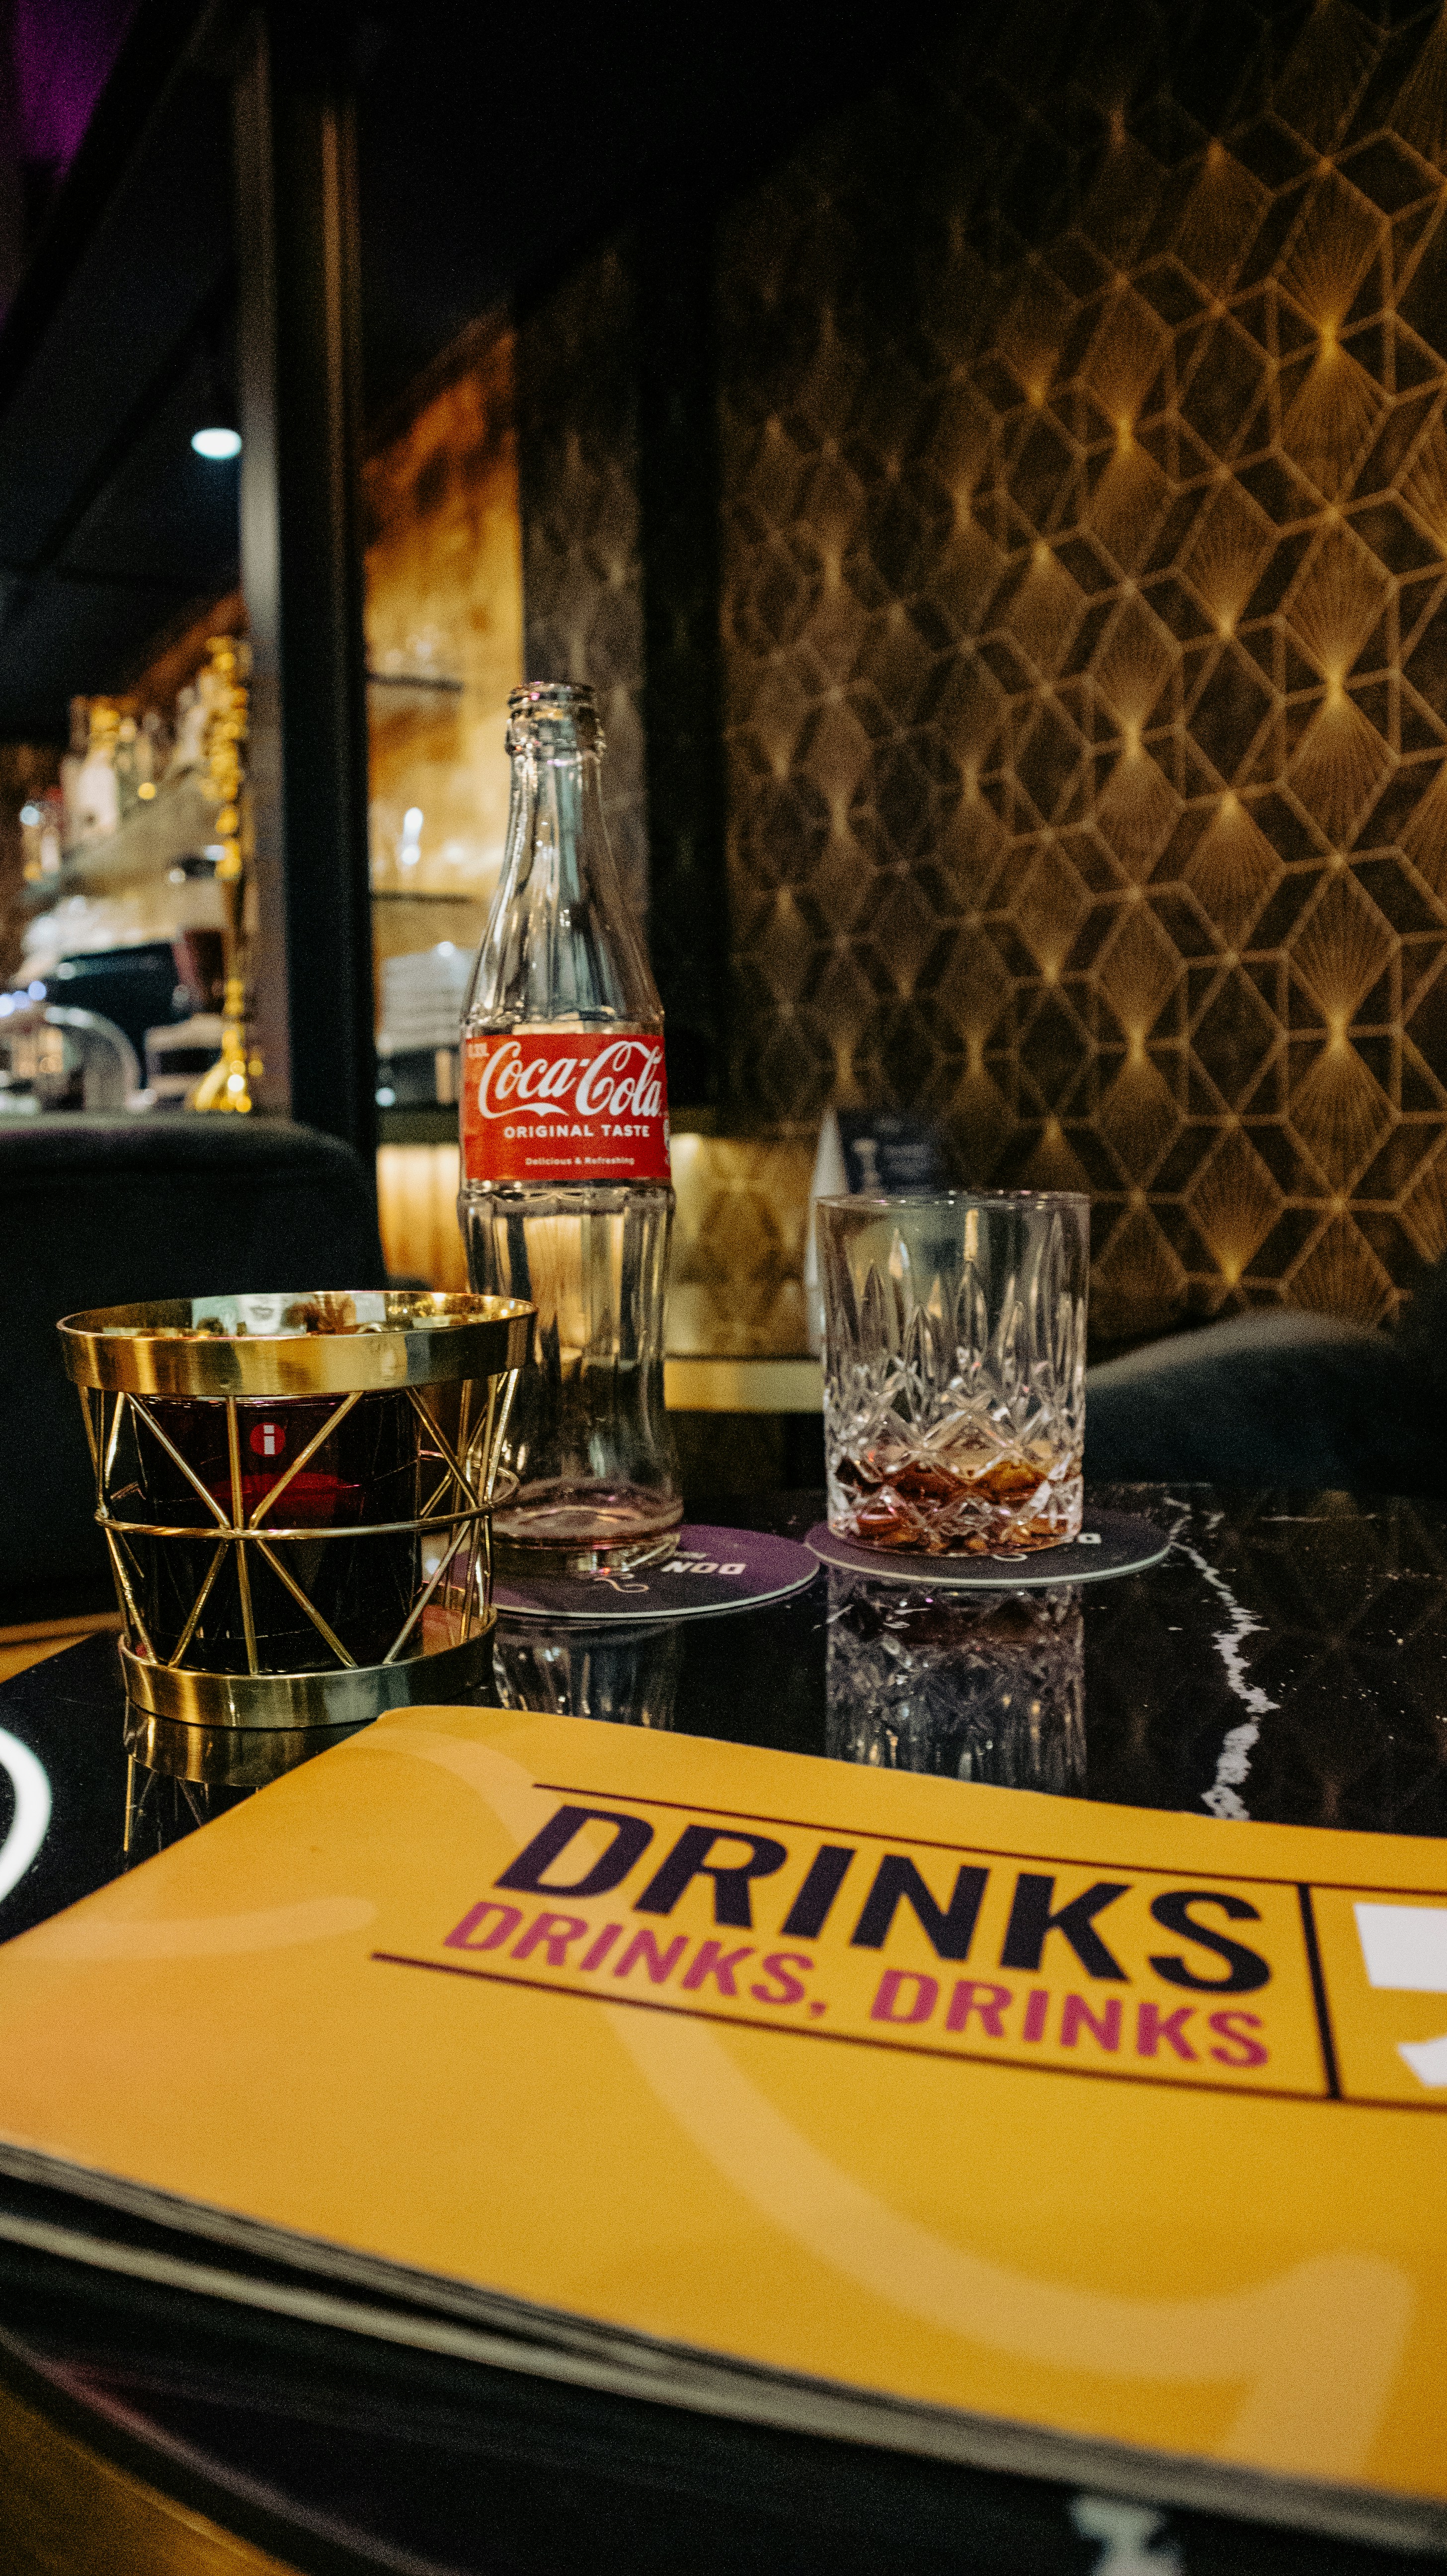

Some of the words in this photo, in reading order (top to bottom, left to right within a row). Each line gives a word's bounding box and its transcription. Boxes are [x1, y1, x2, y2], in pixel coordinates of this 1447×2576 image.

[478, 1041, 663, 1119] Coca-Cola
[504, 1125, 594, 1138] ORIGINAL
[601, 1124, 650, 1138] TASTE
[574, 1156, 582, 1165] &
[584, 1156, 635, 1166] Refreshing
[492, 1804, 1273, 1994] DRINKS
[442, 1900, 828, 2019] DRINKS,
[869, 1969, 1270, 2069] DRINKS
